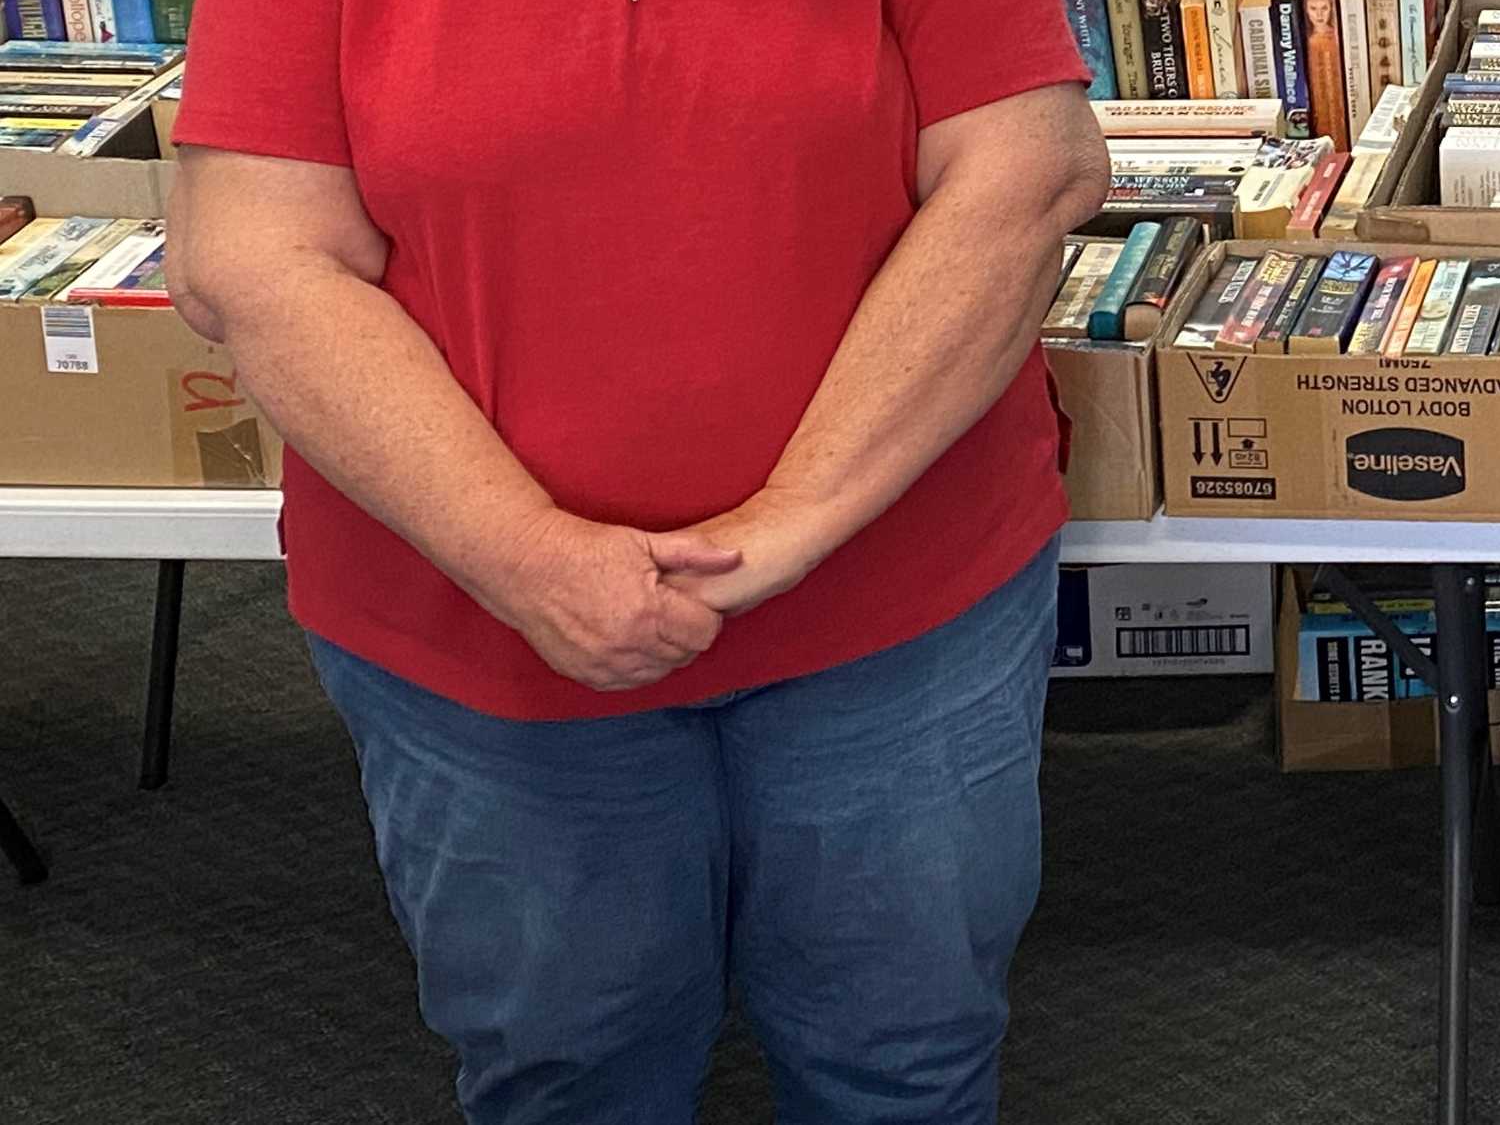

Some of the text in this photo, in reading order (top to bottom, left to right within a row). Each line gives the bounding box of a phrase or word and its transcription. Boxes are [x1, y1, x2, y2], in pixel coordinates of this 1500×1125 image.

[1160, 12, 1173, 43] TWO
[1250, 19, 1269, 73] CARDINAL
[1151, 52, 1166, 90] BRUCE
[1163, 44, 1178, 87] TIGERS
[1279, 3, 1301, 103] Danny Wallace
[1297, 374, 1400, 392] STRENGTH
[1341, 398, 1471, 417] BODY LOTION
[1353, 452, 1462, 478] Vaseline
[1360, 638, 1387, 701] RANK
